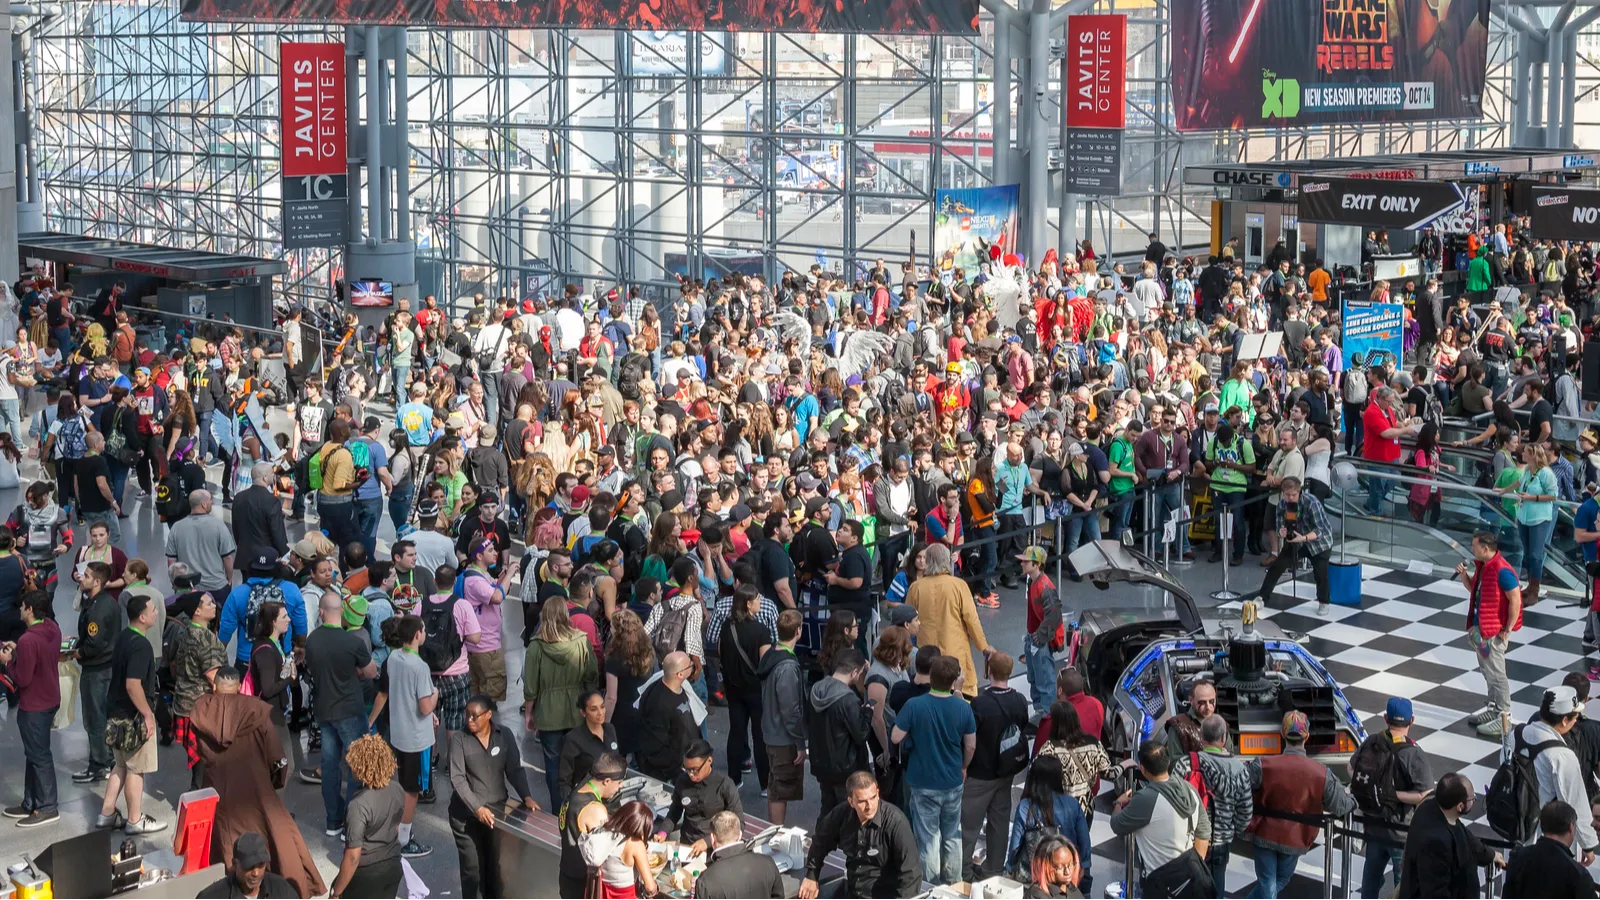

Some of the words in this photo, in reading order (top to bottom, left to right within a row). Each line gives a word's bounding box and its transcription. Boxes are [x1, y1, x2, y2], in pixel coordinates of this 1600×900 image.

[1326, 13, 1385, 39] WARS
[1079, 31, 1094, 111] JAVITS
[1099, 31, 1111, 111] CENTER
[1317, 45, 1394, 74] REBELS
[294, 60, 313, 157] JAVITS
[321, 60, 336, 157] CENTER
[1262, 78, 1300, 119] XD
[1304, 88, 1321, 107] NEW
[1323, 87, 1355, 107] SEASON
[1357, 87, 1401, 105] PREMIERES
[1408, 87, 1423, 104] OCT
[1424, 87, 1432, 104] 14
[301, 174, 333, 201] 1C
[1213, 171, 1274, 186] CHASE
[1341, 193, 1377, 211] EXIT
[1380, 195, 1421, 213] ONLY
[1572, 206, 1600, 224] NO
